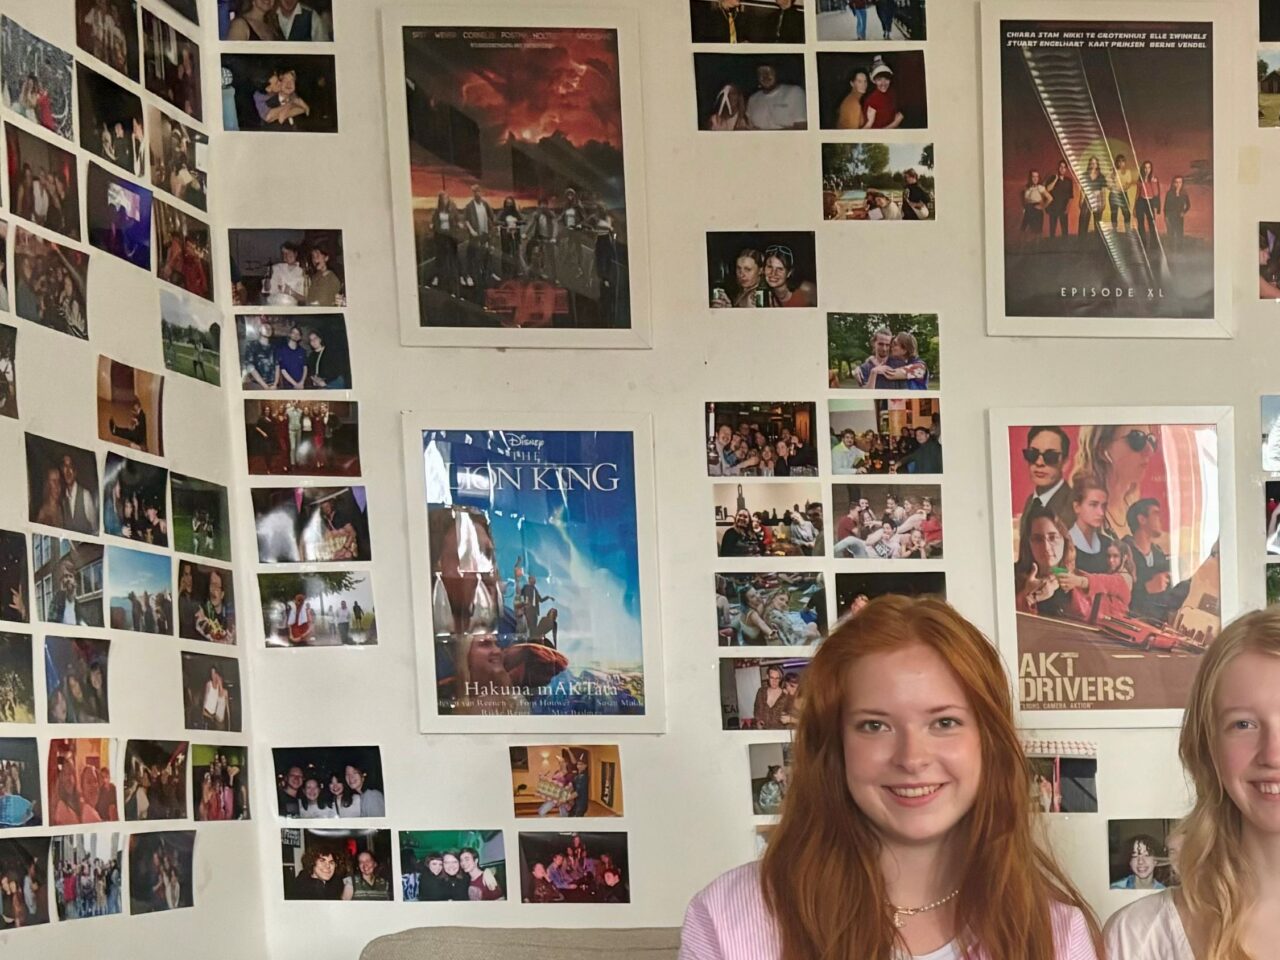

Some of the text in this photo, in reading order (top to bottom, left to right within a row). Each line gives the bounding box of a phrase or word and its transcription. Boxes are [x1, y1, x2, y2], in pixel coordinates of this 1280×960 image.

[1061, 287, 1164, 298] EPISODE XL
[505, 432, 545, 447] Disney
[532, 462, 621, 491] KING
[1019, 652, 1080, 677] AKT
[465, 681, 532, 696] Hakuna
[1018, 676, 1136, 702] DRIVERS
